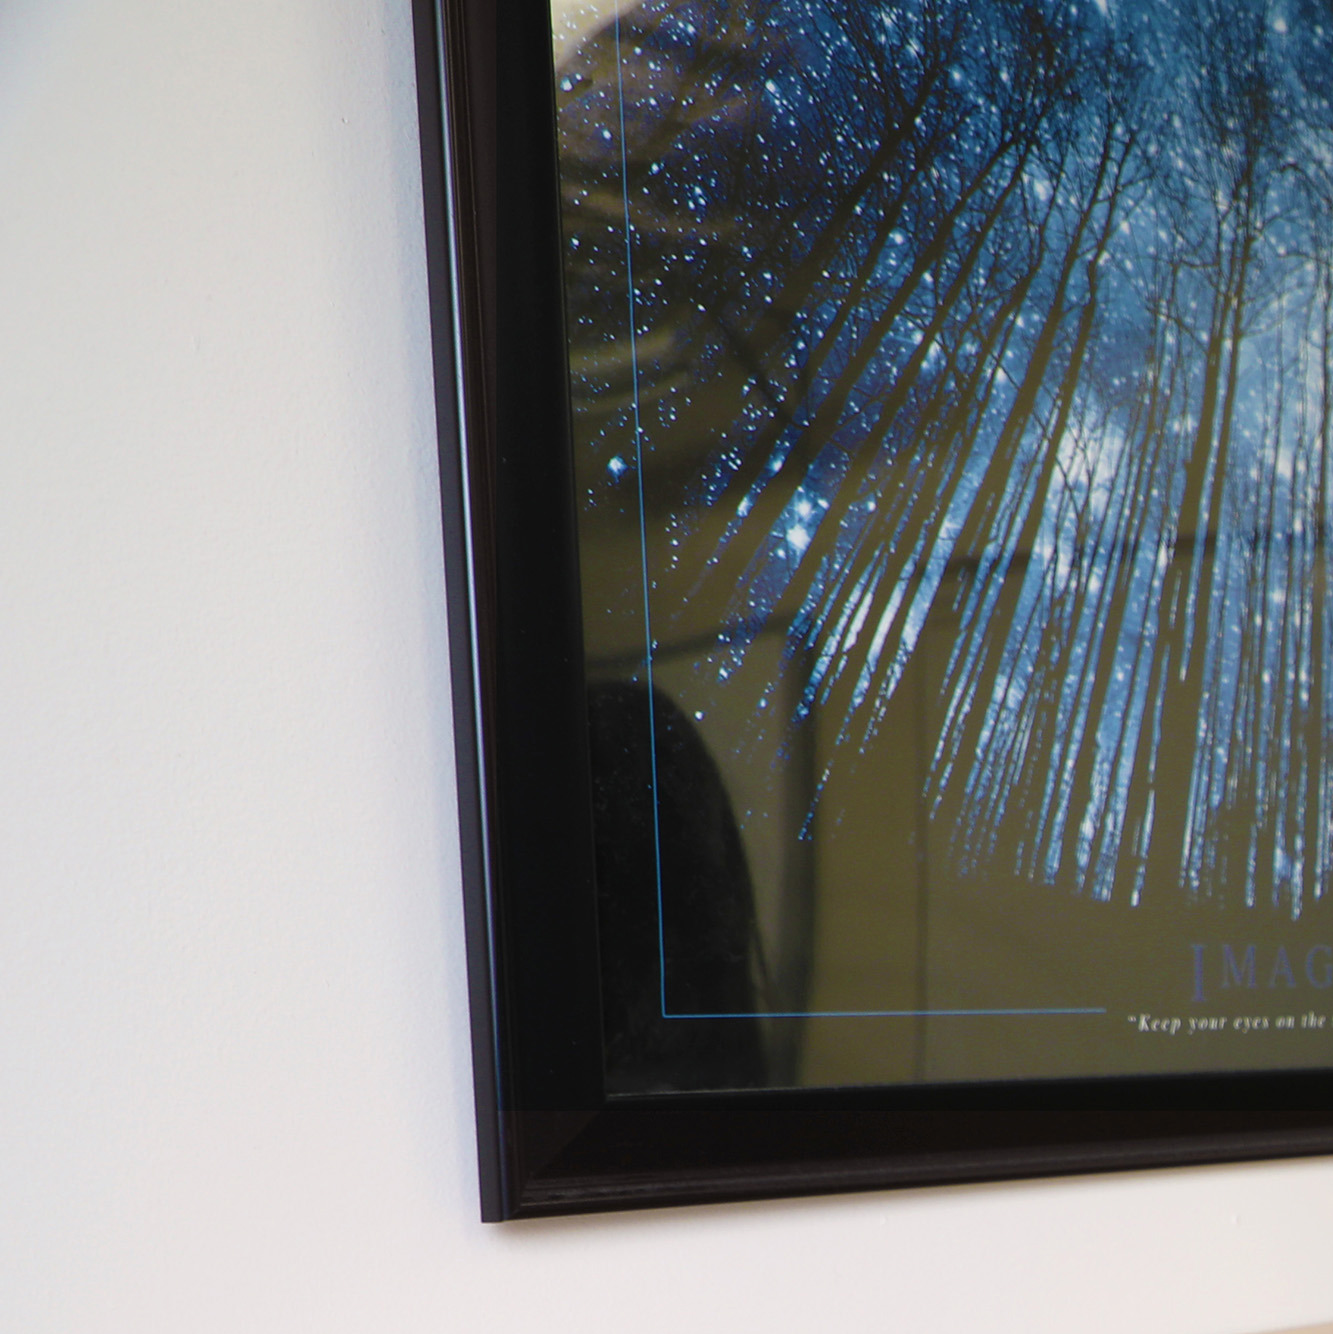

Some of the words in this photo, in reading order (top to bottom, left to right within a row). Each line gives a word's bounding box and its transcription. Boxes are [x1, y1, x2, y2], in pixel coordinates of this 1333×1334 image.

[1188, 1017, 1227, 1035] your
[1232, 1017, 1270, 1034] eyes
[1275, 1017, 1295, 1029] on
[1300, 1010, 1326, 1029] the
